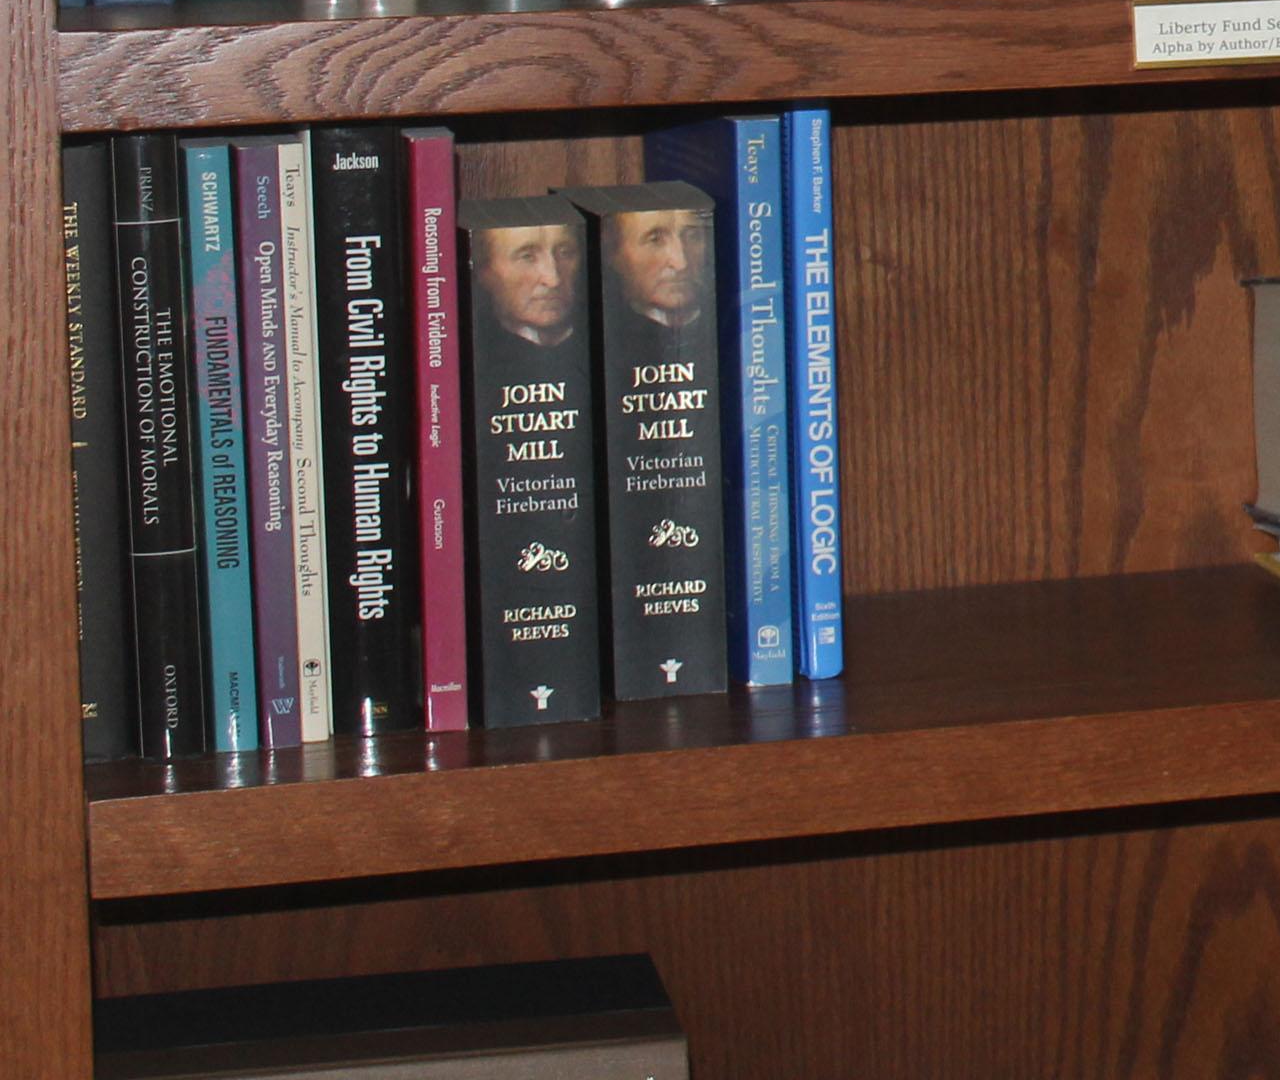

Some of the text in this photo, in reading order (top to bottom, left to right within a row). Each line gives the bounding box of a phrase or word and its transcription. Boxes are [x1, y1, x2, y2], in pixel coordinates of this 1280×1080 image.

[1159, 21, 1216, 37] Liberty
[1222, 18, 1261, 33] Fund
[1152, 41, 1193, 56] Alpha
[1198, 40, 1215, 54] by
[333, 153, 379, 171] Jackson
[201, 172, 221, 252] SCHWARTZ
[744, 134, 779, 415] Teays Second Thoughts
[254, 176, 286, 532] Seech Open Minds AND Everyday Reasoning
[131, 257, 160, 525] CONSTRUCTION OF MORALS
[156, 308, 178, 467] THE EMOTIONAL
[502, 382, 565, 408] JOHN
[805, 229, 836, 575] THE ELEMENTS OF LOGIC
[342, 235, 393, 620] From Civil Rights to Human Rights
[490, 410, 579, 434] STUART
[205, 316, 240, 570] FUNDAMENTALS of REASONING
[507, 440, 564, 462] MILL
[496, 475, 576, 494] Victorian
[496, 493, 579, 515] Firebrand
[433, 499, 445, 550] Gustason
[504, 605, 576, 622] RICHARD
[512, 624, 570, 642] REEVES
[164, 664, 179, 729] OXFORD
